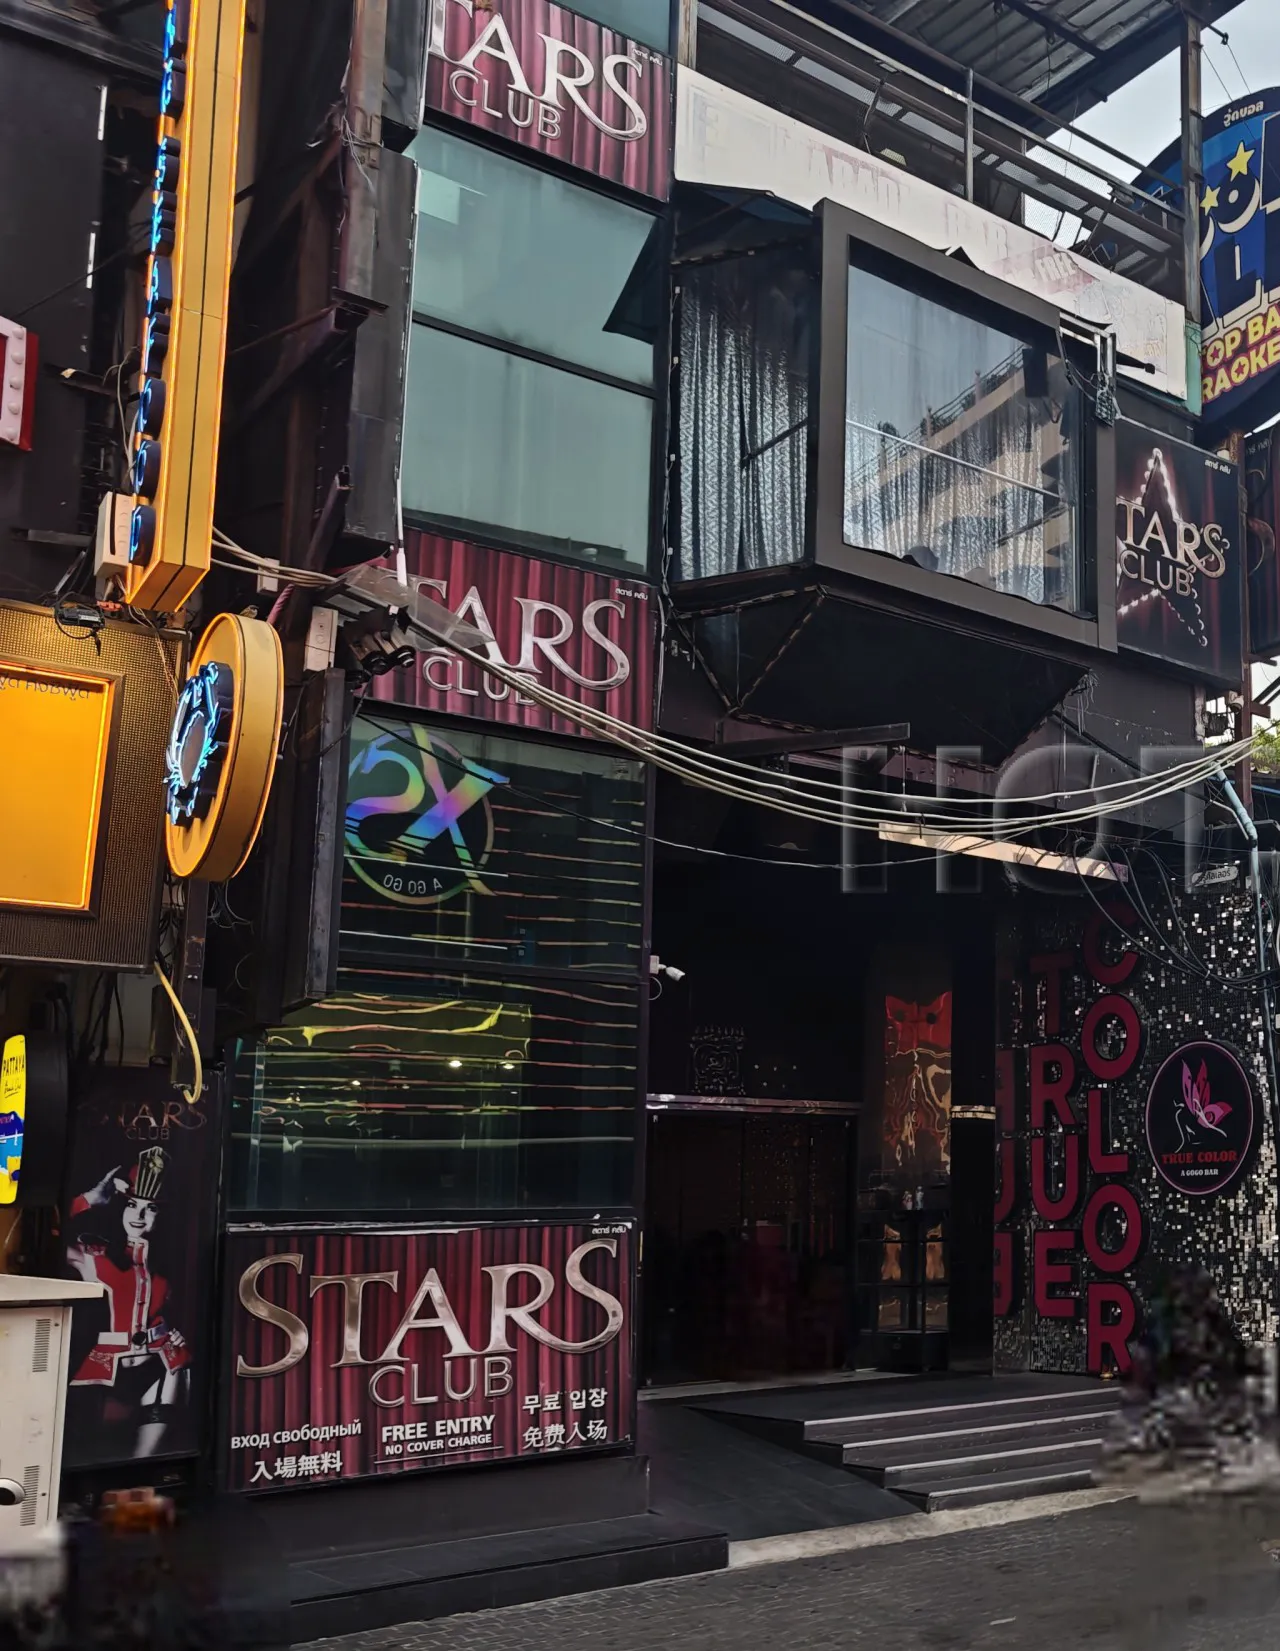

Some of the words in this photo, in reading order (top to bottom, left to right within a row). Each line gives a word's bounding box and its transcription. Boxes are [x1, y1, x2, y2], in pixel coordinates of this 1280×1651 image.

[428, 0, 648, 141] TARS
[449, 69, 562, 140] CLUB
[1203, 329, 1242, 367] OP
[1116, 498, 1226, 579] TARS
[1121, 550, 1192, 597] CLUB
[422, 655, 539, 706] CLUB
[1030, 951, 1080, 1318] TRUE
[1081, 900, 1141, 1373] COLOR
[1161, 1152, 1193, 1164] TRUE
[1197, 1150, 1237, 1163] COLOR
[1204, 1168, 1219, 1176] BAR
[236, 1238, 624, 1378] STARS
[368, 1356, 514, 1409] CLUB
[522, 1393, 561, 1414] 무료
[569, 1387, 608, 1411] 입장
[382, 1422, 428, 1443] FREE
[435, 1414, 495, 1437] ENTRY
[385, 1444, 402, 1456] NO
[407, 1439, 444, 1453] COVER
[448, 1433, 492, 1448] CHARGE
[522, 1419, 608, 1449] 免费入场
[250, 1450, 343, 1483] 入場無料
